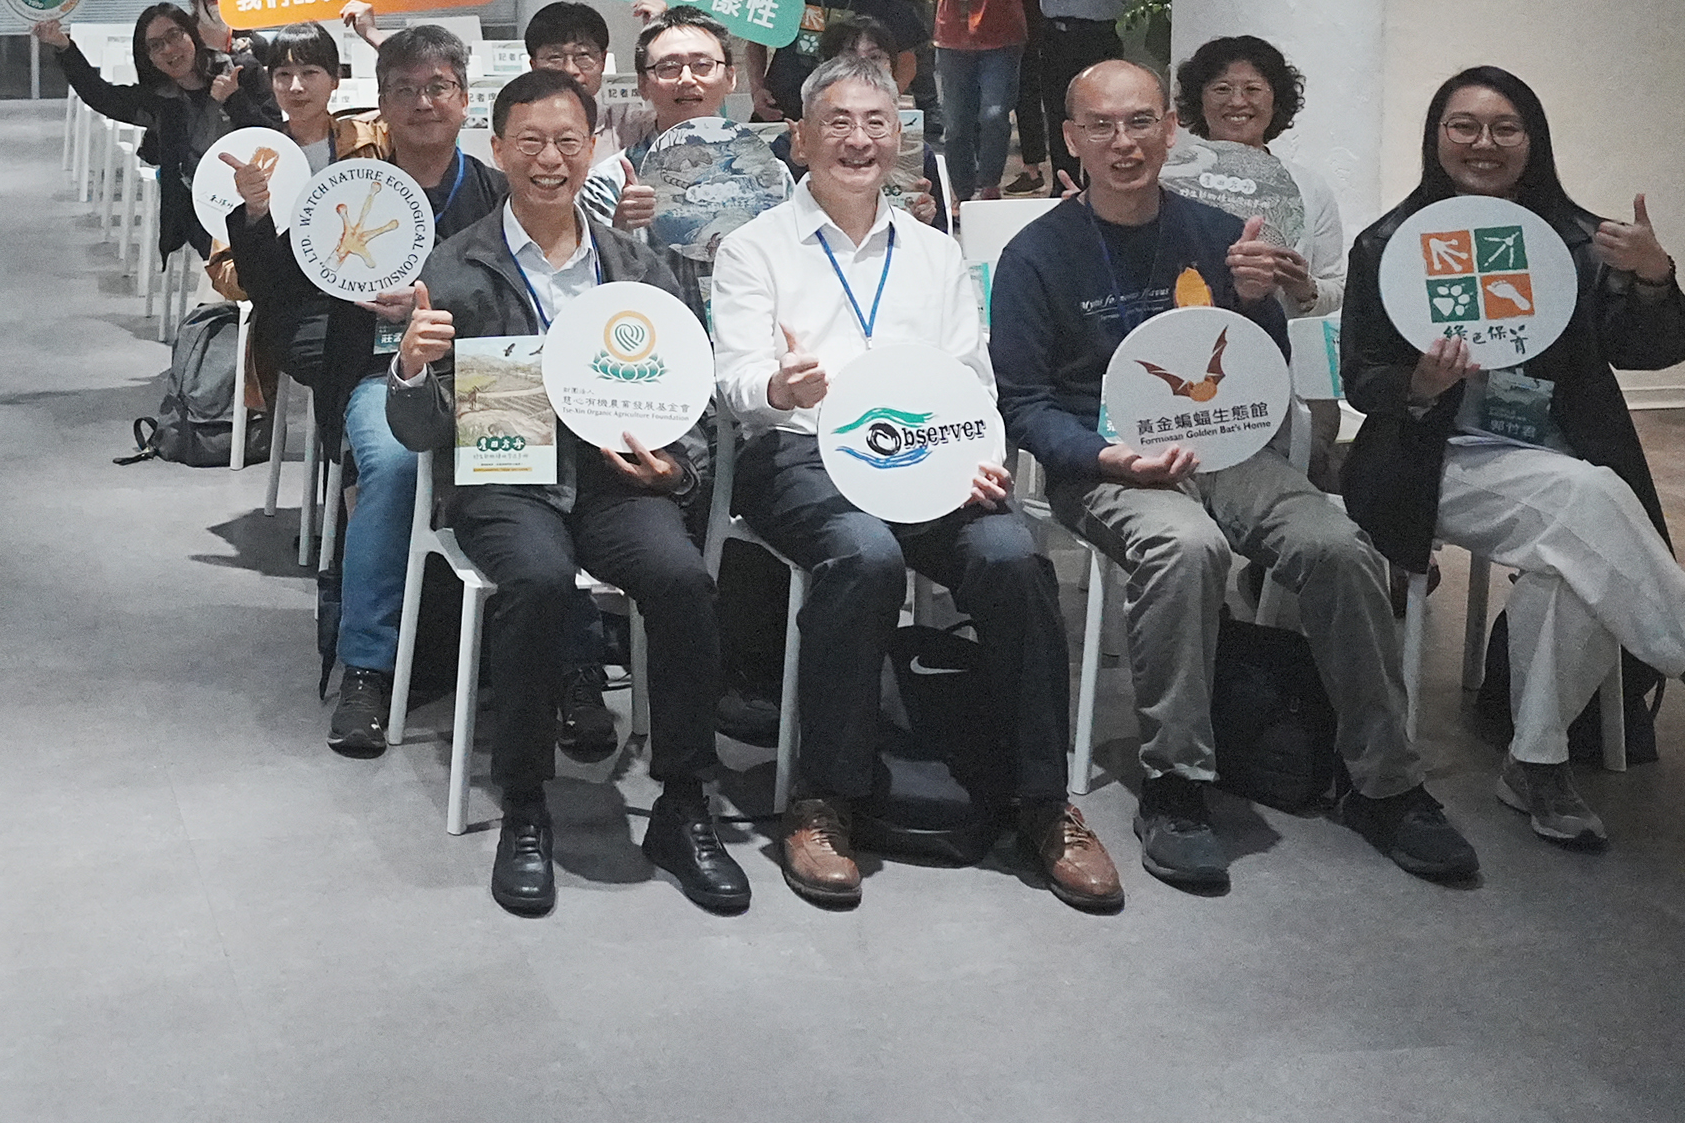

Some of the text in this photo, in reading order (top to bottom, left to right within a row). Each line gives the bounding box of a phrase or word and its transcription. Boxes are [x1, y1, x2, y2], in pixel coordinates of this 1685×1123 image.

[328, 168, 383, 187] NATURE
[299, 183, 329, 227] WATCH
[385, 175, 426, 250] ECOLOGICAL
[338, 253, 419, 293] CONSULTANT
[1443, 324, 1529, 355] 綠色保育
[562, 395, 690, 414] 慈心有機農業發展基金會
[587, 408, 612, 417] Organic
[614, 411, 650, 419] Agriculture
[651, 413, 690, 422] Foundation
[1136, 401, 1269, 436] 黃金蝙蝠生態館
[866, 418, 986, 456] Observer
[1140, 420, 1272, 446] Formosan Golden Bat's Home
